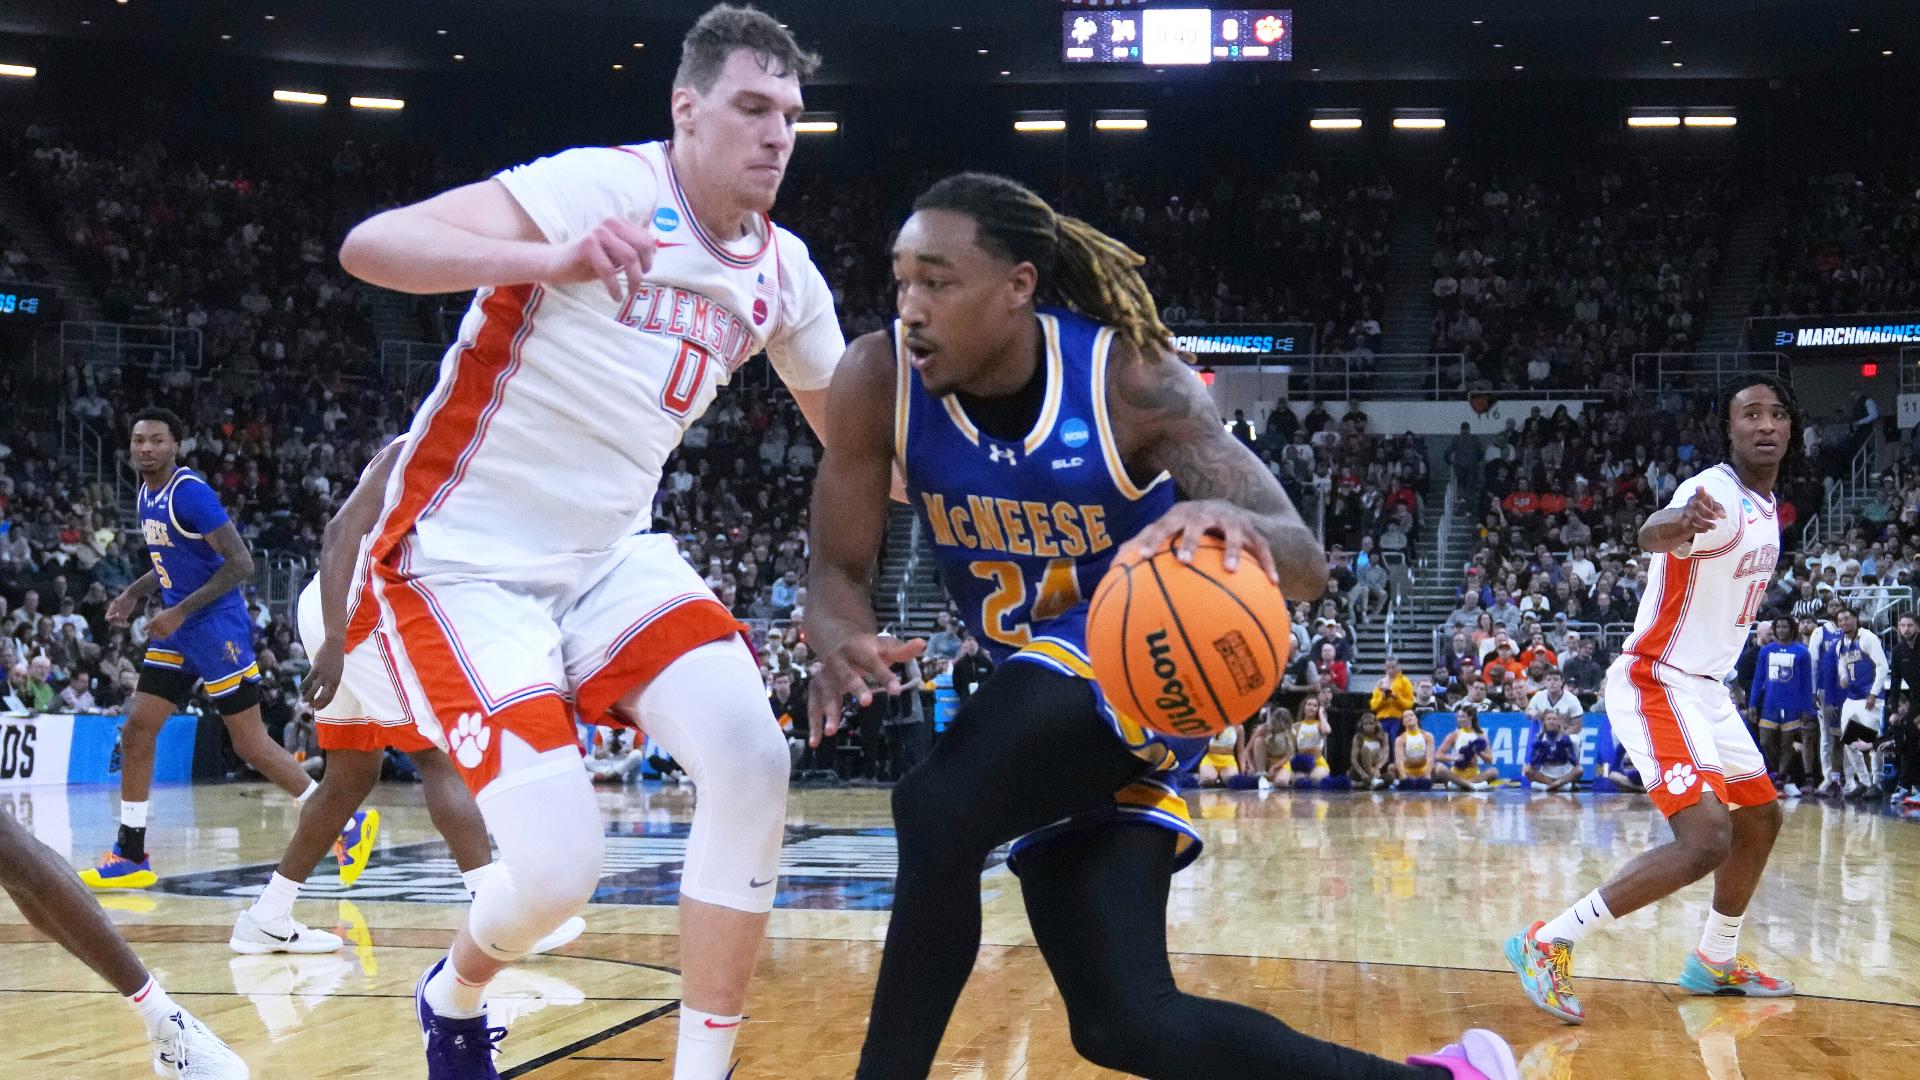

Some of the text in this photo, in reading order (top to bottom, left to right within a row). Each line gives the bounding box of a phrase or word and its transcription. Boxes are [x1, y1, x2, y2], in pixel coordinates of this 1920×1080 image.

[661, 339, 709, 417] 0
[921, 492, 1113, 557] McNEESE
[150, 551, 172, 588] 5
[968, 558, 1082, 648] 24
[1145, 628, 1211, 735] Wilson
[0, 724, 37, 779] DS
